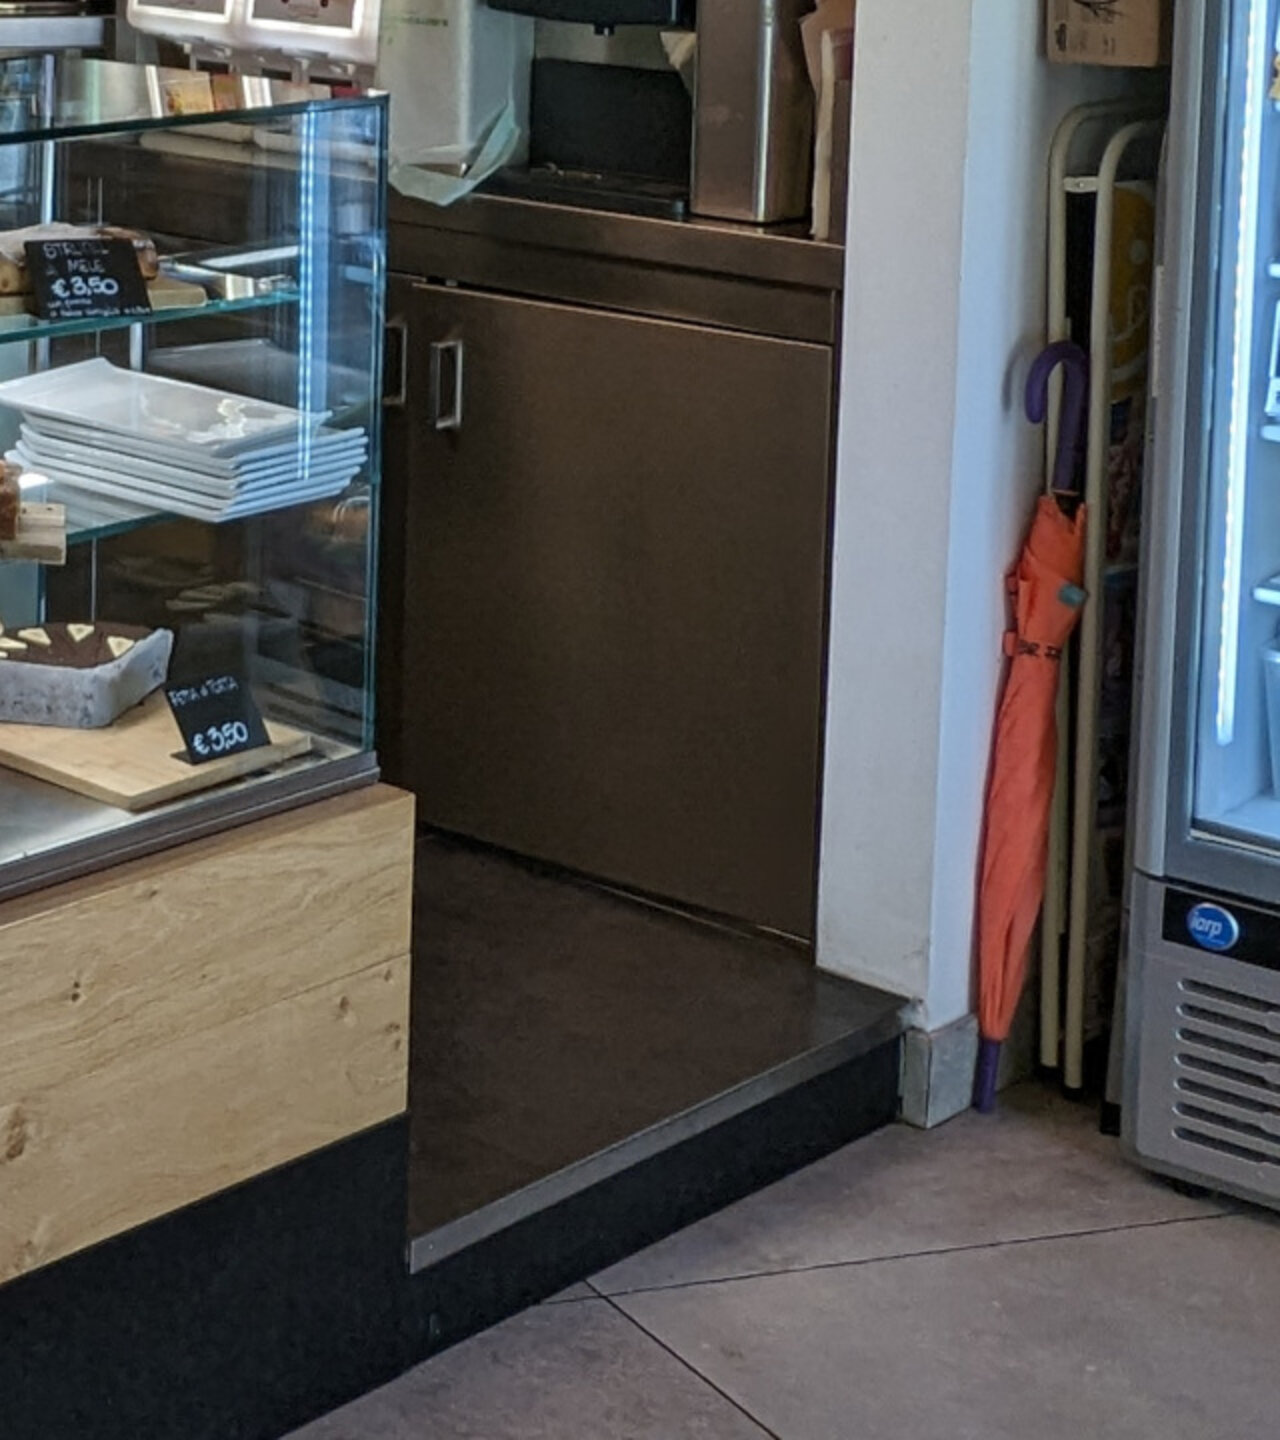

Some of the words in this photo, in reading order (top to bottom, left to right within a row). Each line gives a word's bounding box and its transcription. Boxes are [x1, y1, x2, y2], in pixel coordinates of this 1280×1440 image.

[50, 275, 119, 298] €3,50
[192, 721, 249, 756] €3,50
[1191, 911, 1223, 940] iarp
